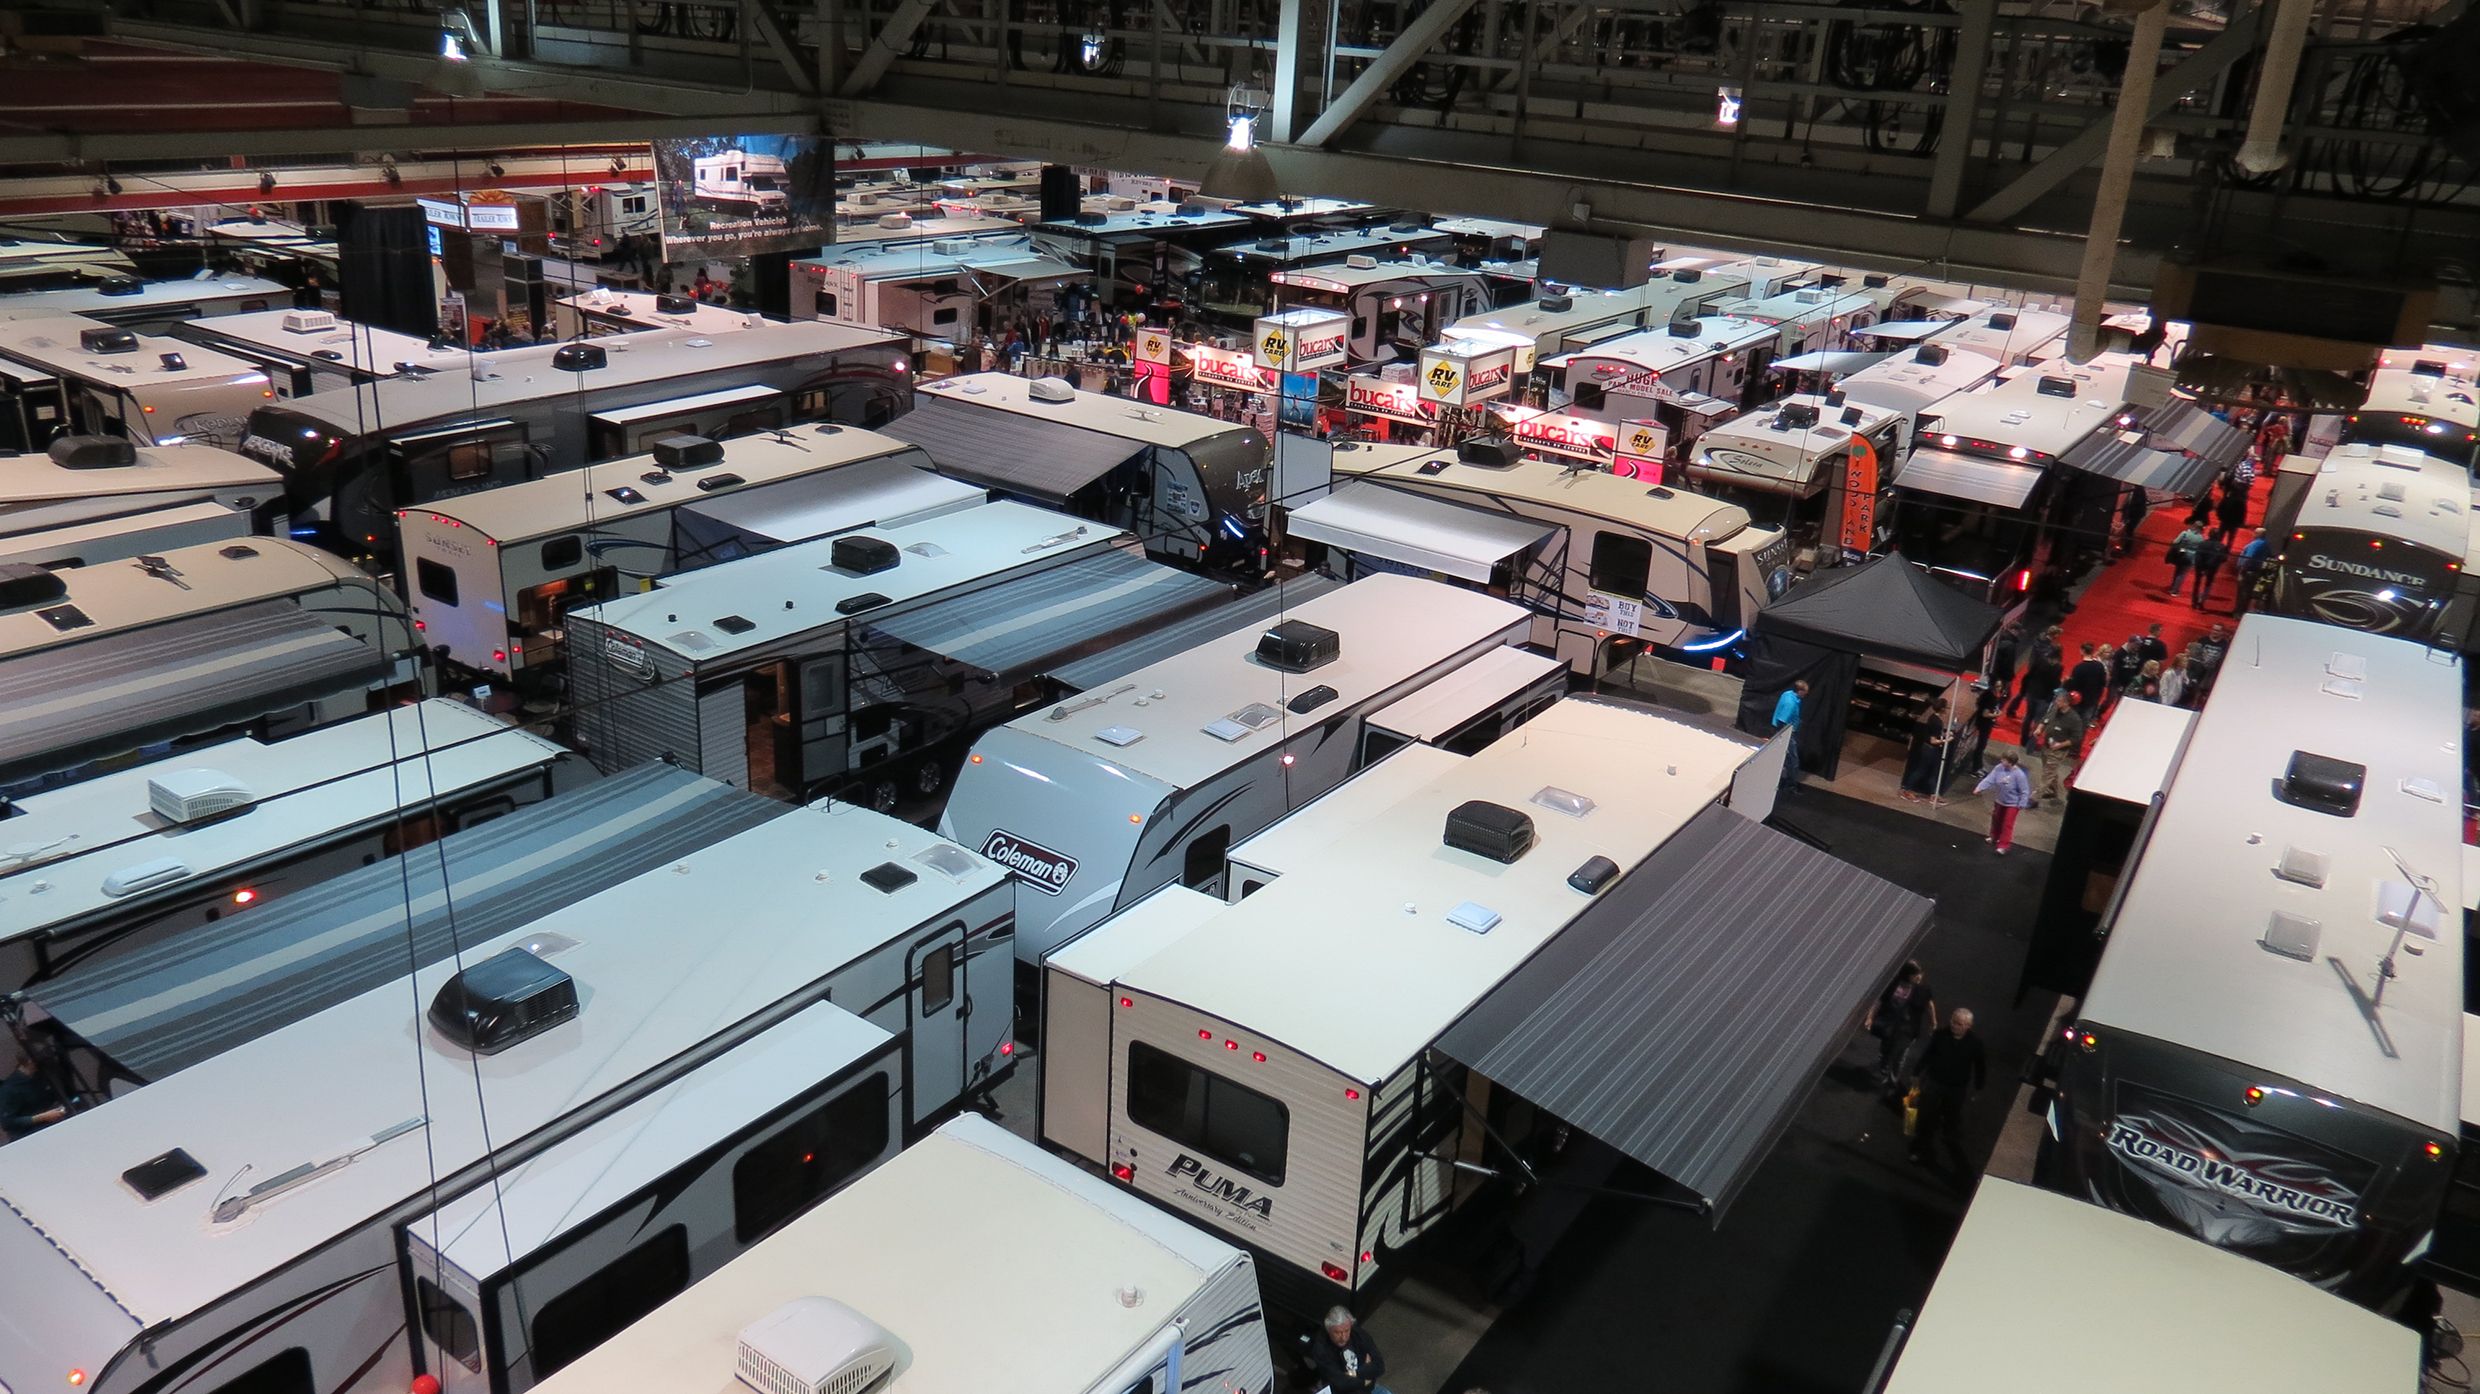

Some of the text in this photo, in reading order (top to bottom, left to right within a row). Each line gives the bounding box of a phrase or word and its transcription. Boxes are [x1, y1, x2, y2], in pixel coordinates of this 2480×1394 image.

[709, 216, 787, 230] Recreation Vehicles
[665, 234, 706, 245] Wherever
[707, 233, 722, 244] you
[724, 233, 736, 242] go,
[738, 230, 762, 241] you're
[764, 227, 791, 239] always
[1147, 340, 1161, 349] RV
[1265, 337, 1287, 349] RV
[1299, 337, 1334, 356] bucars
[1199, 350, 1258, 380] bucars
[1432, 368, 1457, 381] RV
[1468, 367, 1500, 388] bucars
[1627, 373, 1657, 386] HUGE
[1429, 379, 1452, 388] CARE
[1608, 381, 1627, 389] PARK
[1629, 384, 1653, 393] MODEL
[1657, 388, 1673, 396] SALE
[1349, 380, 1415, 413] bucars
[1519, 414, 1591, 447] bucars
[1631, 442, 1649, 450] CARE
[1633, 434, 1653, 445] RV
[1860, 493, 1871, 533] PARK
[2308, 554, 2428, 587] SUNDANCE
[1618, 600, 1637, 613] BUY
[1620, 609, 1634, 617] THIS
[1617, 619, 1635, 629] NOT
[987, 836, 1053, 881] Coleman
[2107, 1122, 2357, 1228] ROAD WARRIOR
[1165, 1152, 1274, 1221] PUMA
[1173, 1187, 1223, 1217] Anniversary
[1225, 1211, 1257, 1232] Edition
